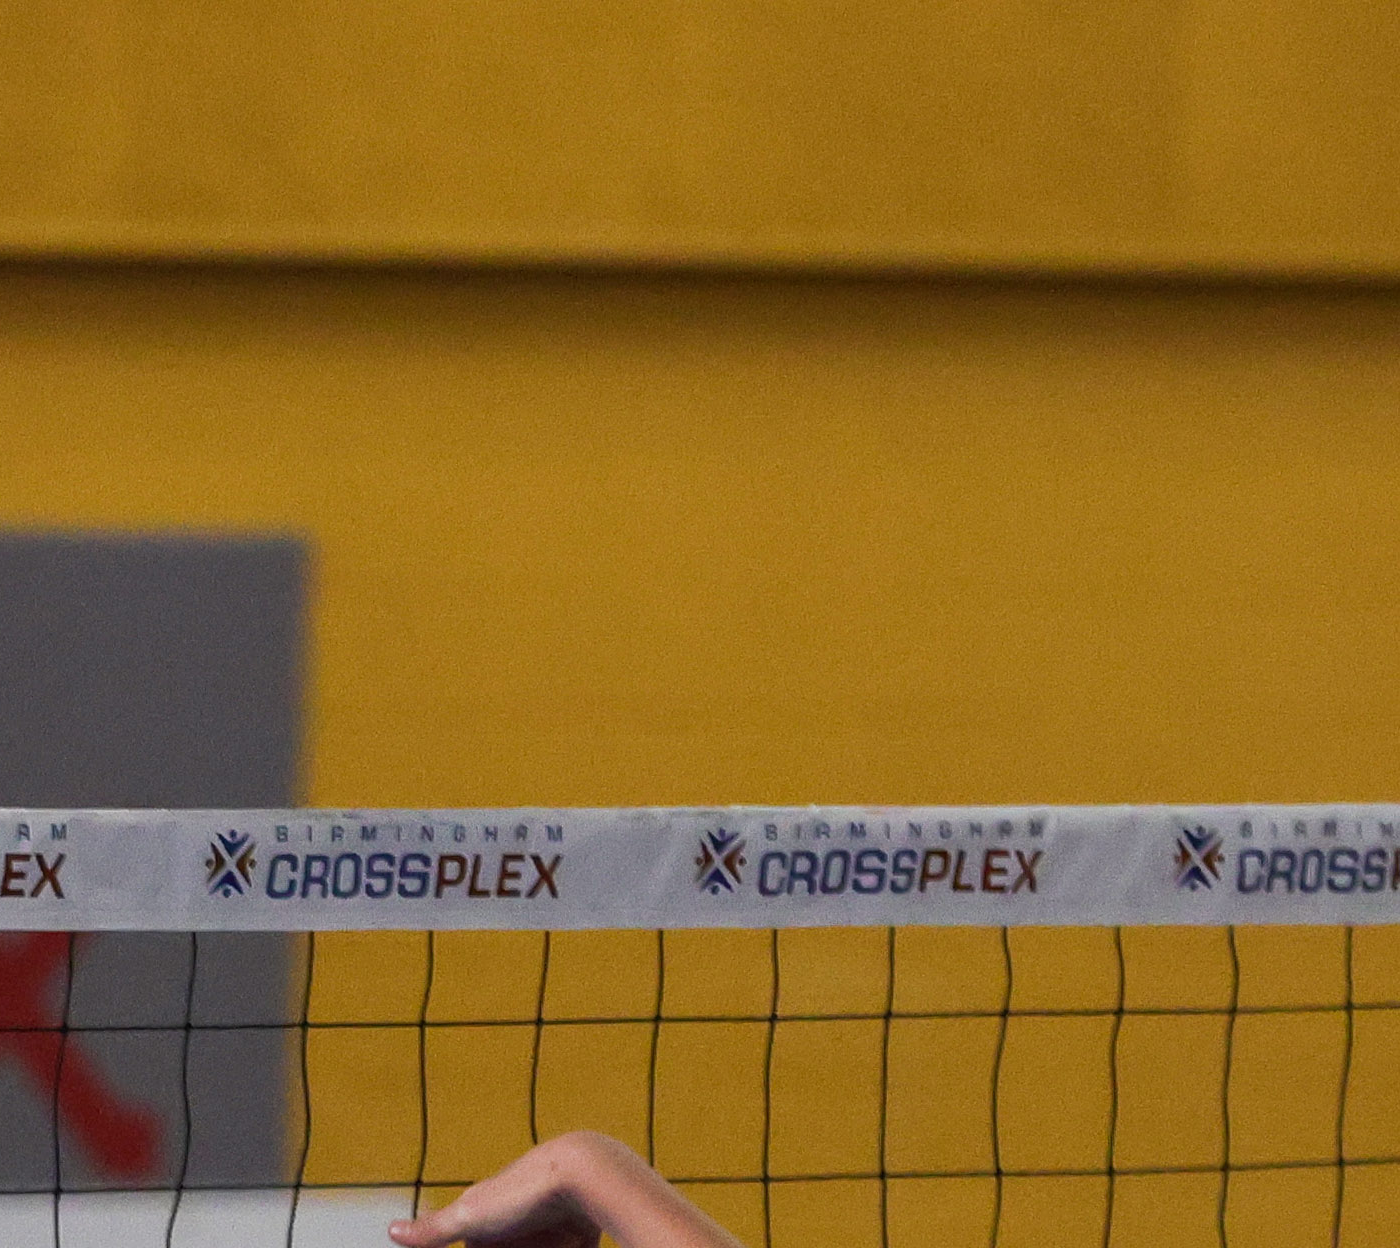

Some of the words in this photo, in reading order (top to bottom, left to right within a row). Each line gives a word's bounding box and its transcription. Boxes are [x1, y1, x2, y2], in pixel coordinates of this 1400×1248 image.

[276, 822, 563, 844] BIRMINGHAM
[764, 820, 1046, 841] BIRMINGHAM
[265, 850, 562, 900] CROSSPLEX
[757, 848, 1043, 897] CROSSPLEX
